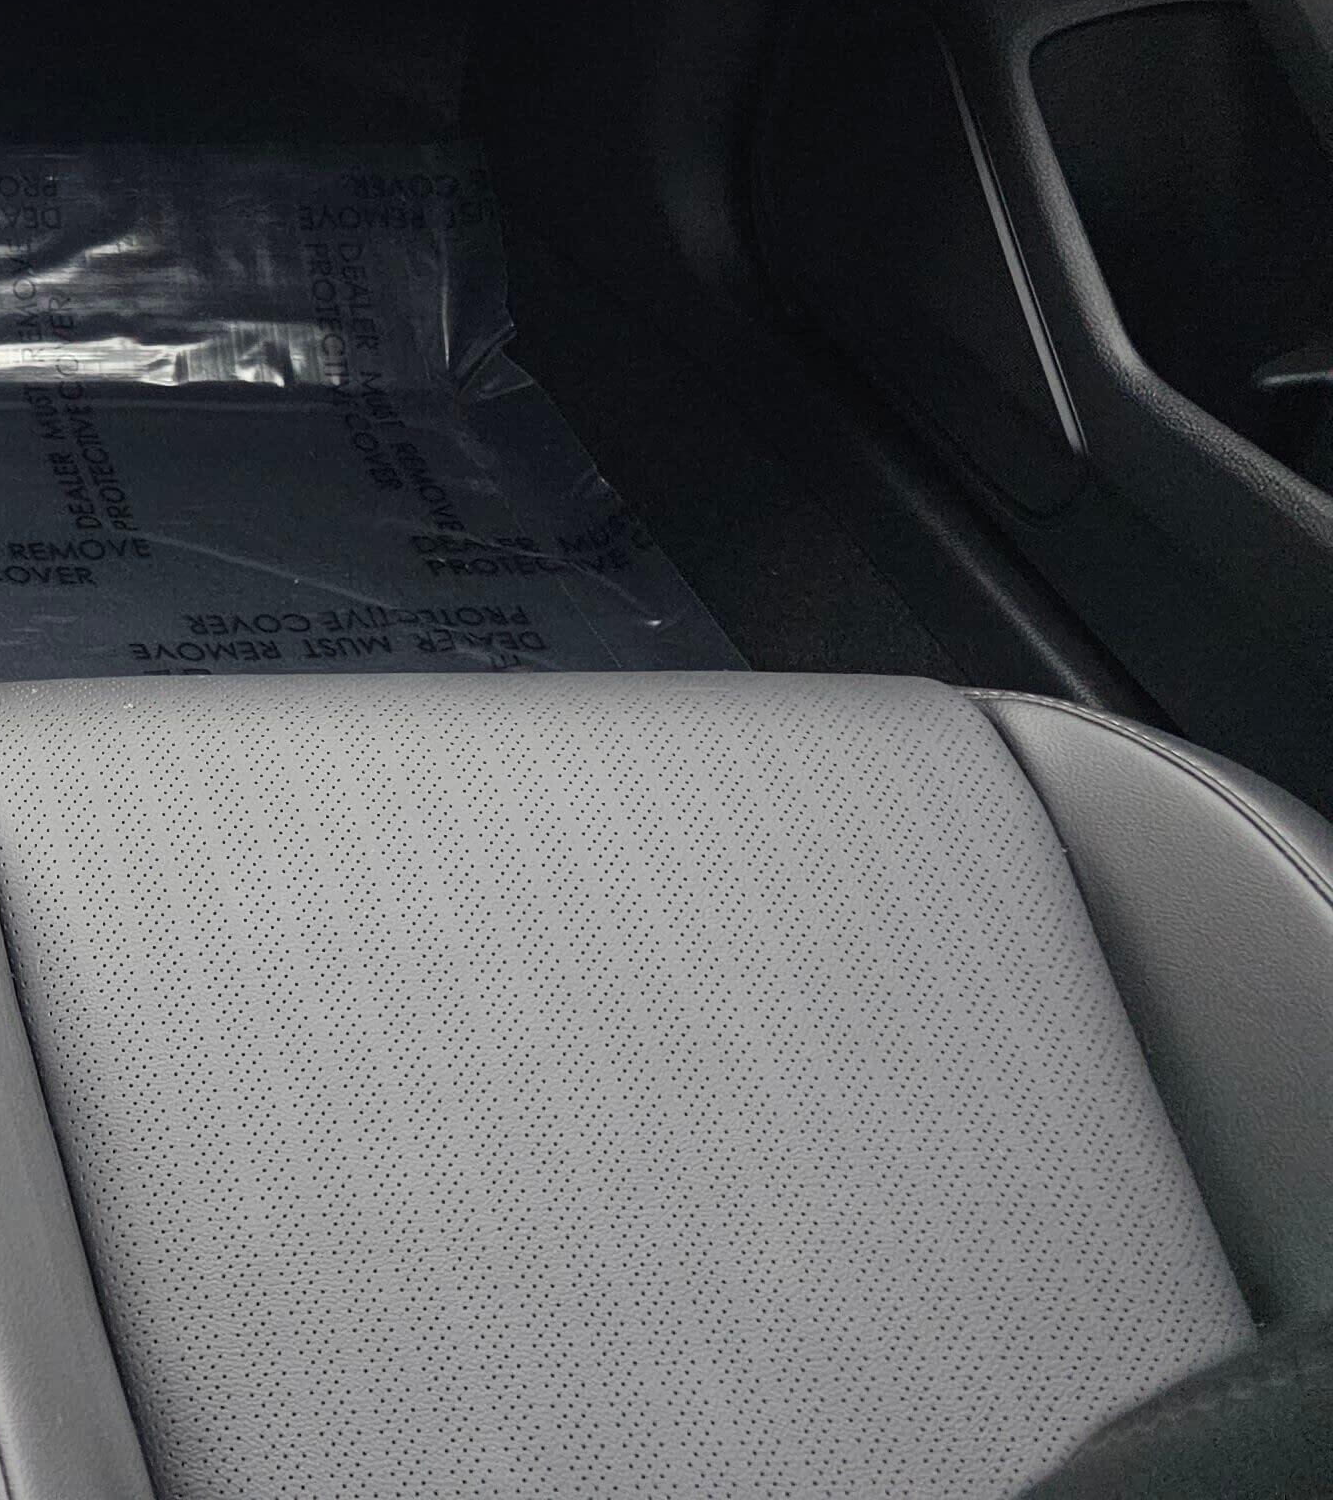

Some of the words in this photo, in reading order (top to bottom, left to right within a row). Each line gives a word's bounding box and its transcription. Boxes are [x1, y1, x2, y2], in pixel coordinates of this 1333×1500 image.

[46, 451, 103, 531] DEALER
[9, 538, 152, 562] REMOVE
[177, 611, 311, 636] COVER
[126, 638, 279, 662] REMOVE
[297, 634, 392, 659] MUST
